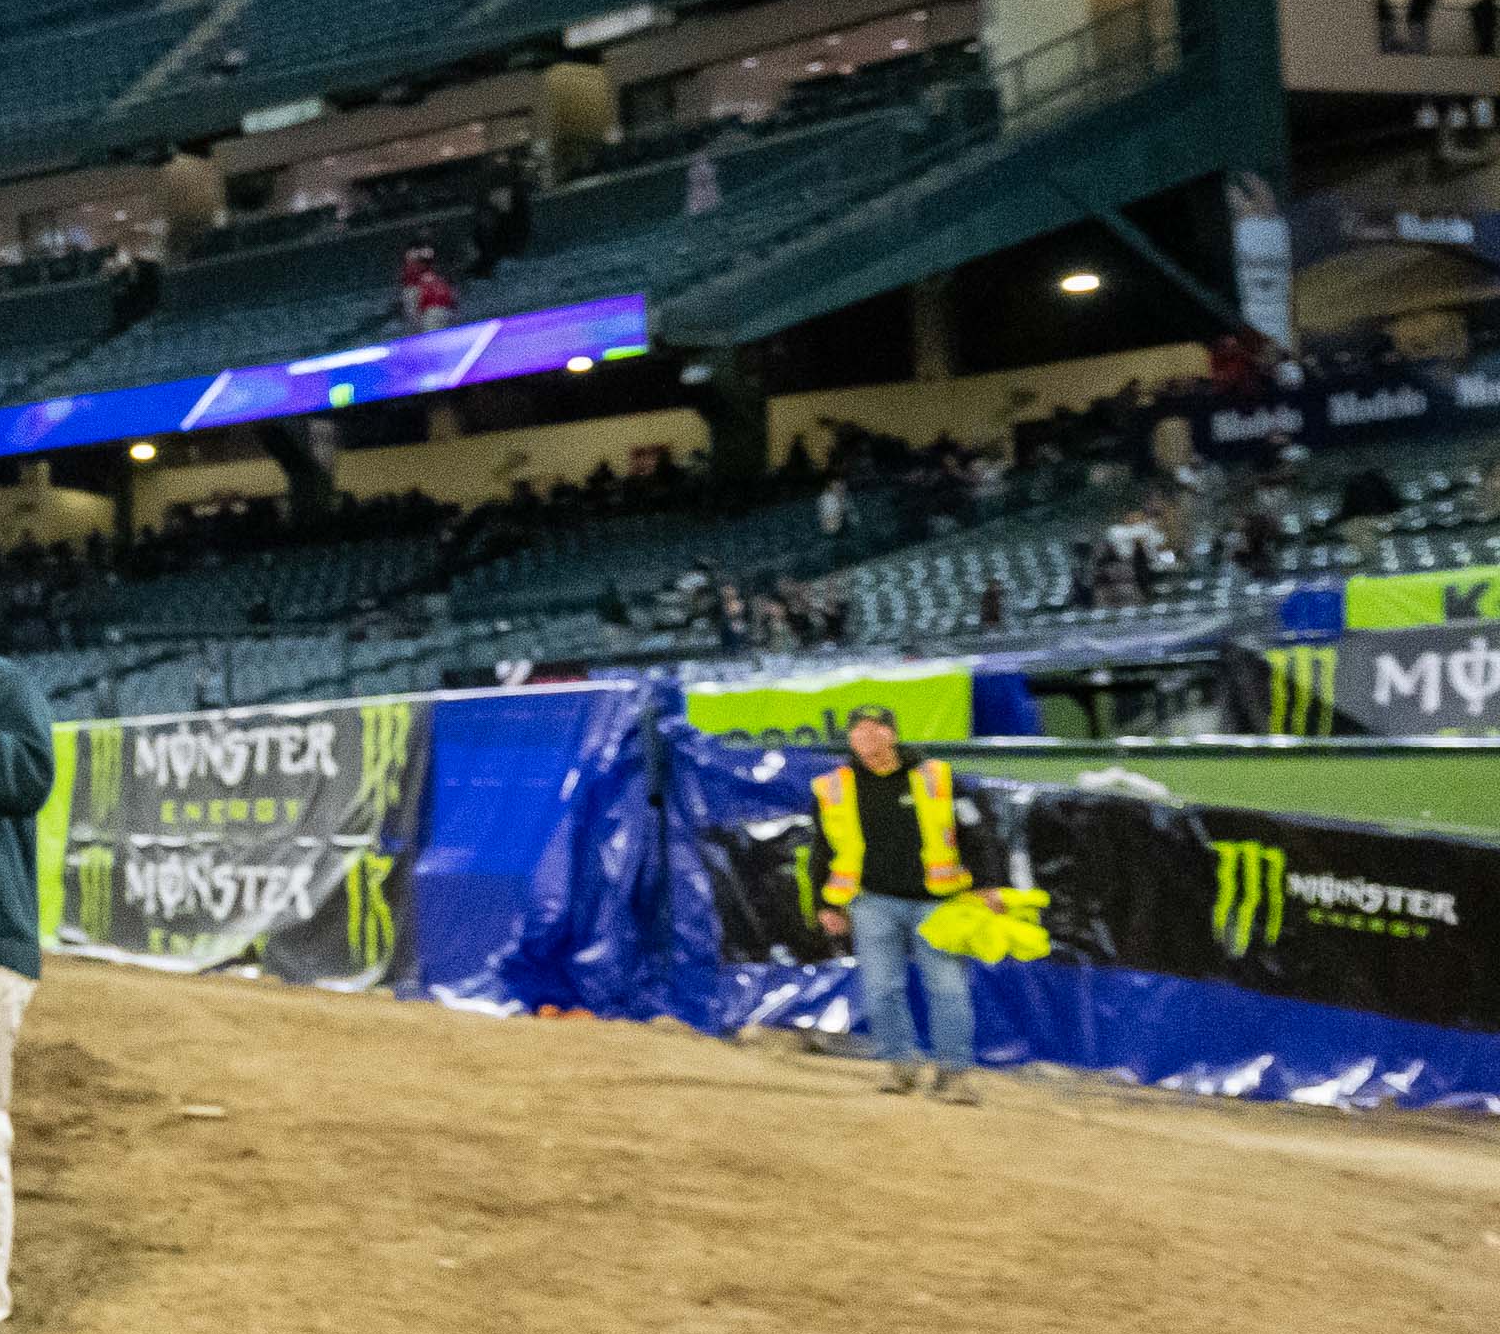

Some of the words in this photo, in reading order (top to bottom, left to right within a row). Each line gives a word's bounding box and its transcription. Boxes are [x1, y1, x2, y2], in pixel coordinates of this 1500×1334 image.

[132, 720, 340, 790] MONSTER
[123, 849, 316, 922] MONSTER
[1285, 871, 1460, 927] MONSTER
